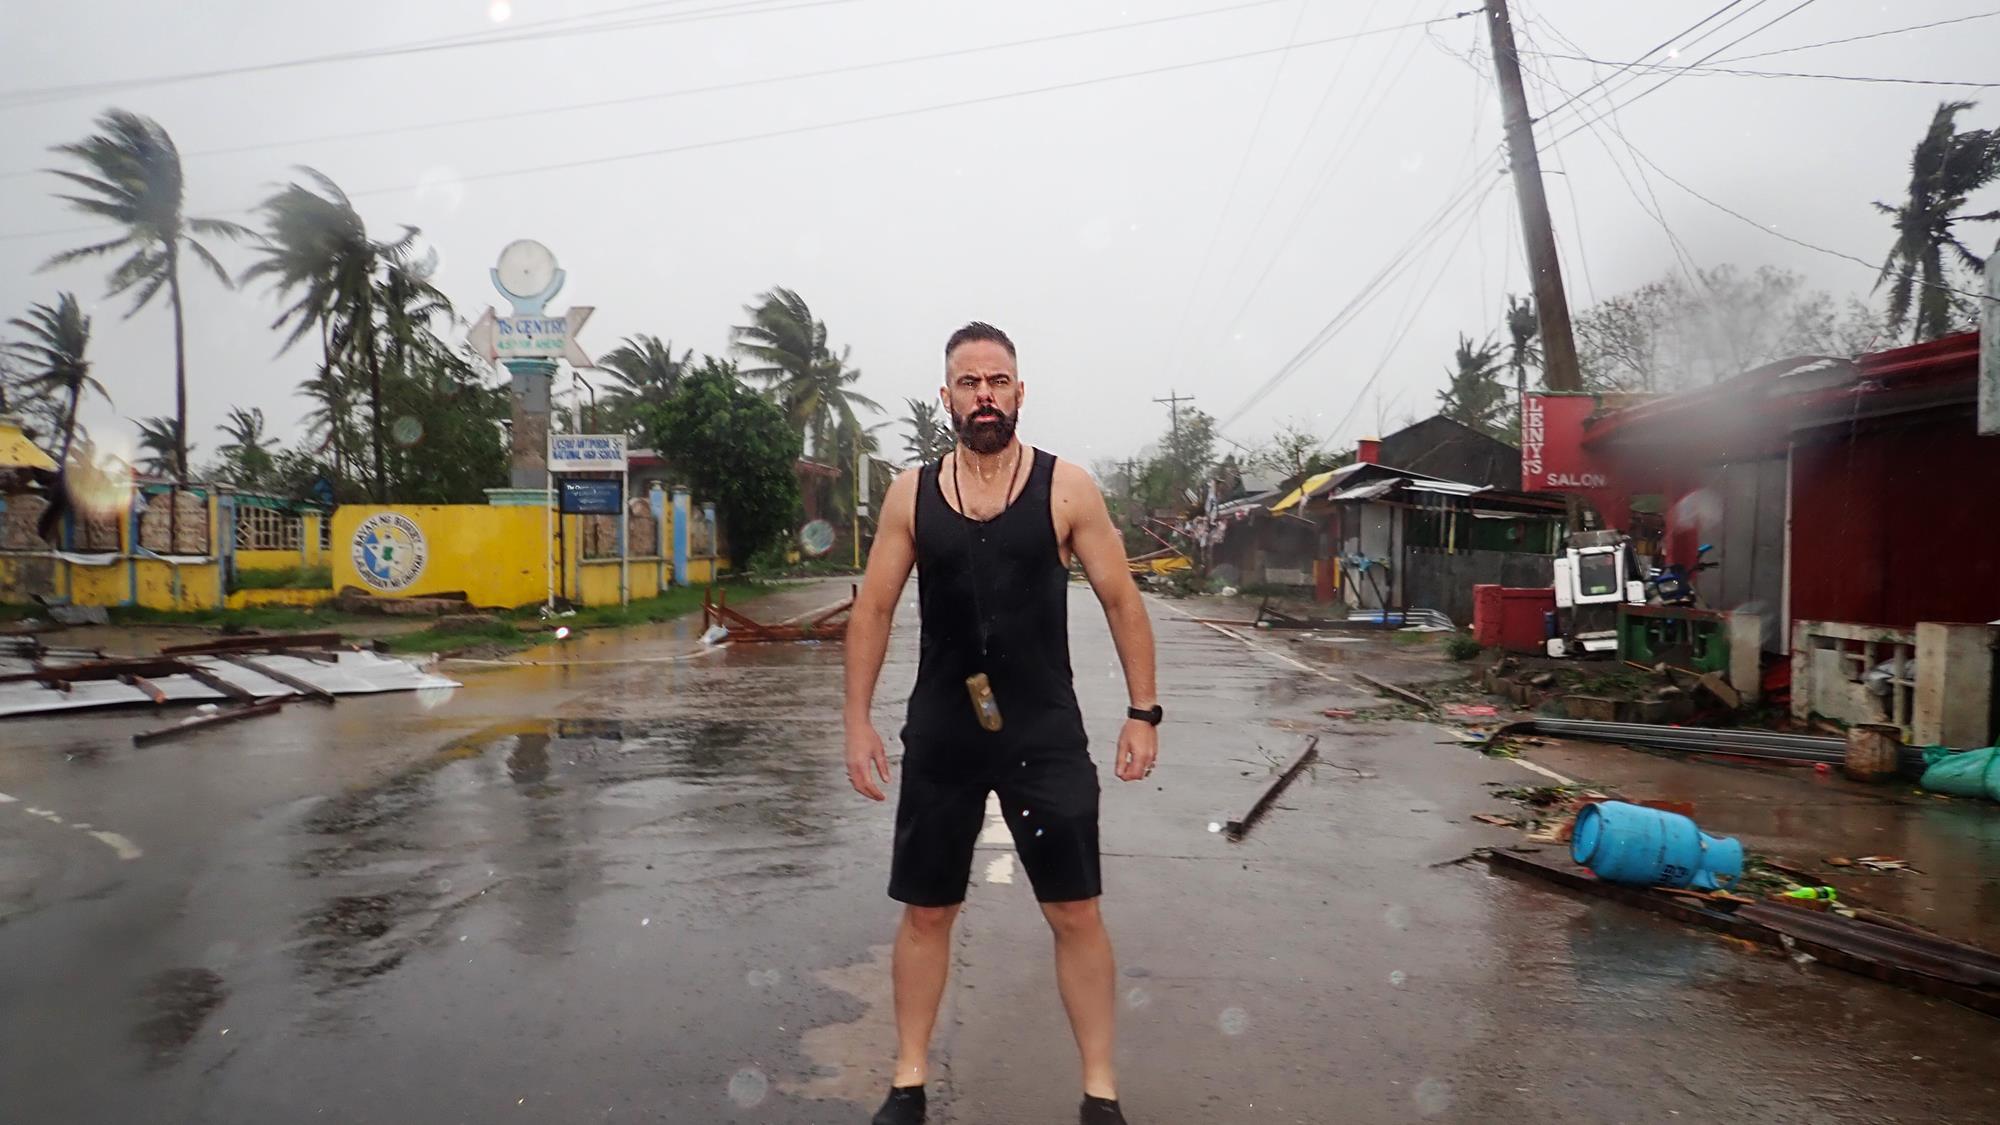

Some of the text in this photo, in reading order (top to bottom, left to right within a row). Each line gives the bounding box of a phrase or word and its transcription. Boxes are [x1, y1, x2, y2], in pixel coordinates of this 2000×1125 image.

[516, 319, 567, 334] CENTRO
[553, 449, 581, 459] NATIONAL
[598, 449, 622, 460] SCHOOL
[1547, 472, 1605, 487] SALON
[354, 518, 378, 547] BAYAN
